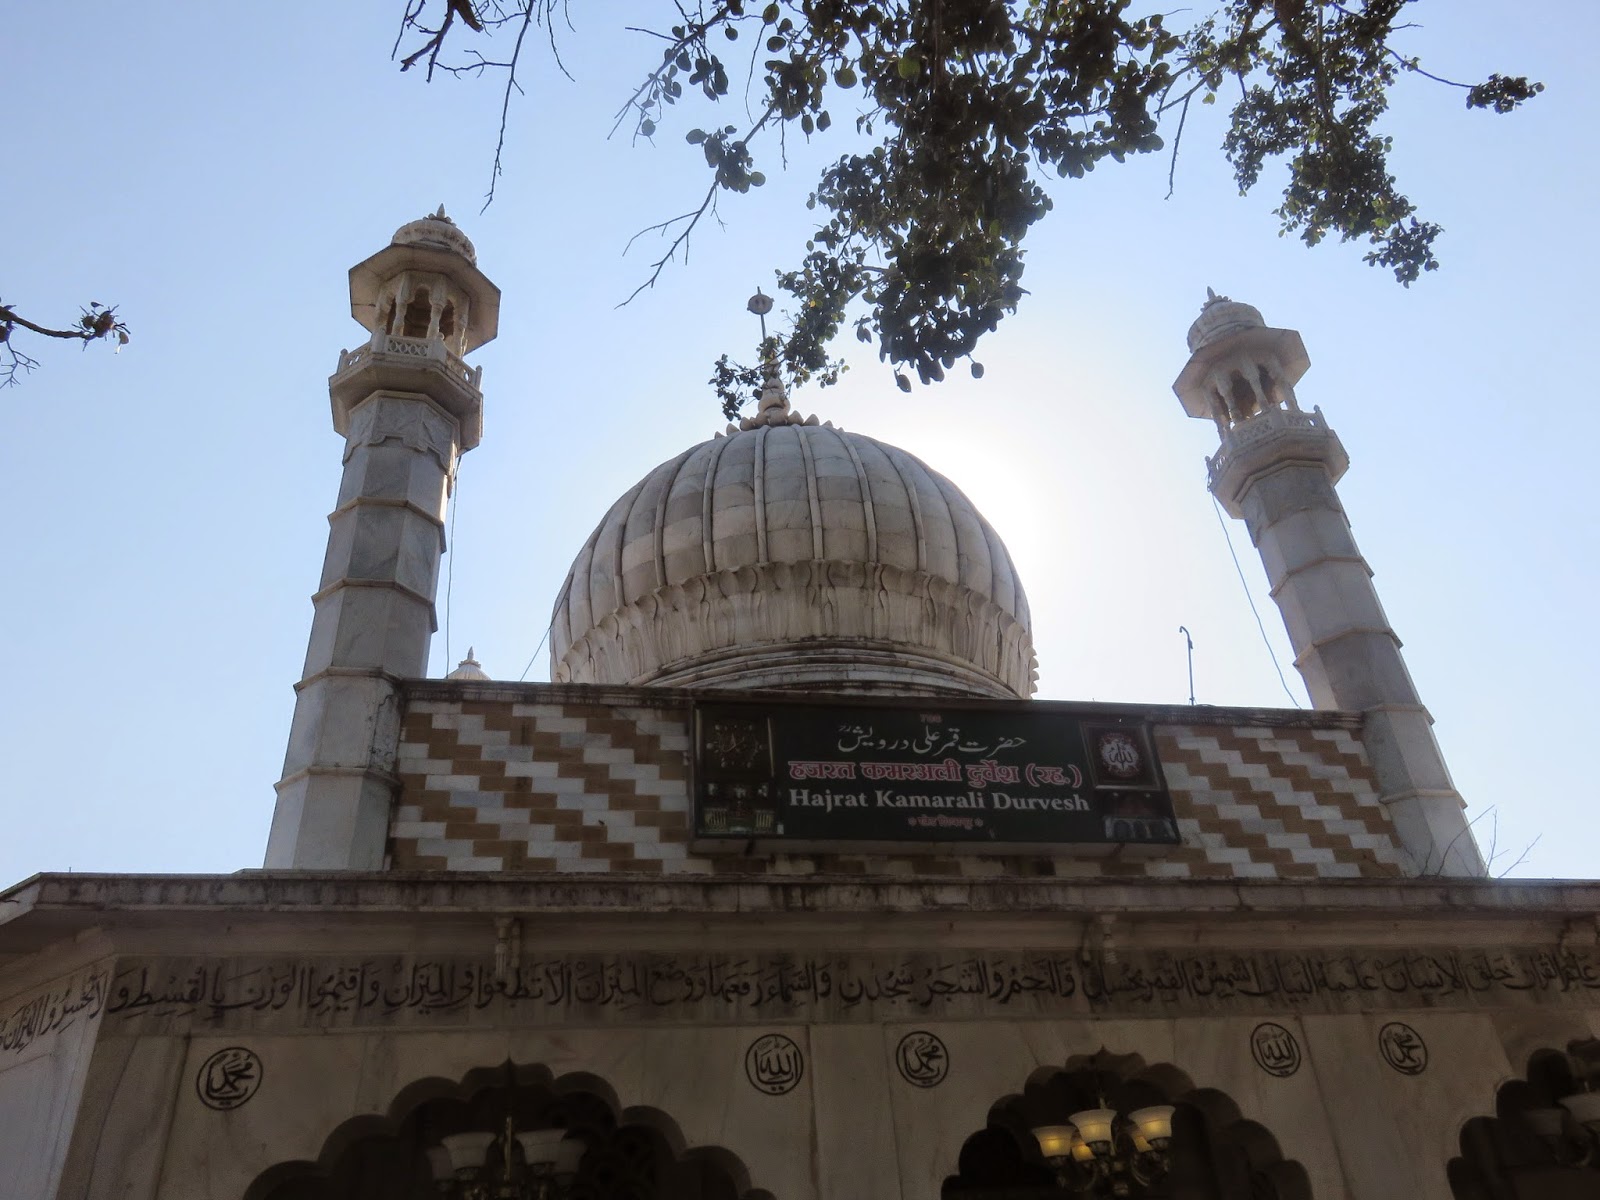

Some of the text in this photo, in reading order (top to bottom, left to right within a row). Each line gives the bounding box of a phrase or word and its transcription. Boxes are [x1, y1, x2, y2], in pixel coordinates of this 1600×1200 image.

[788, 761, 857, 780] हजरत
[860, 758, 964, 781] कमरअली
[966, 759, 1021, 788] दुर्वेश
[789, 788, 1091, 813] Hajrat Kamarali Durvesh
